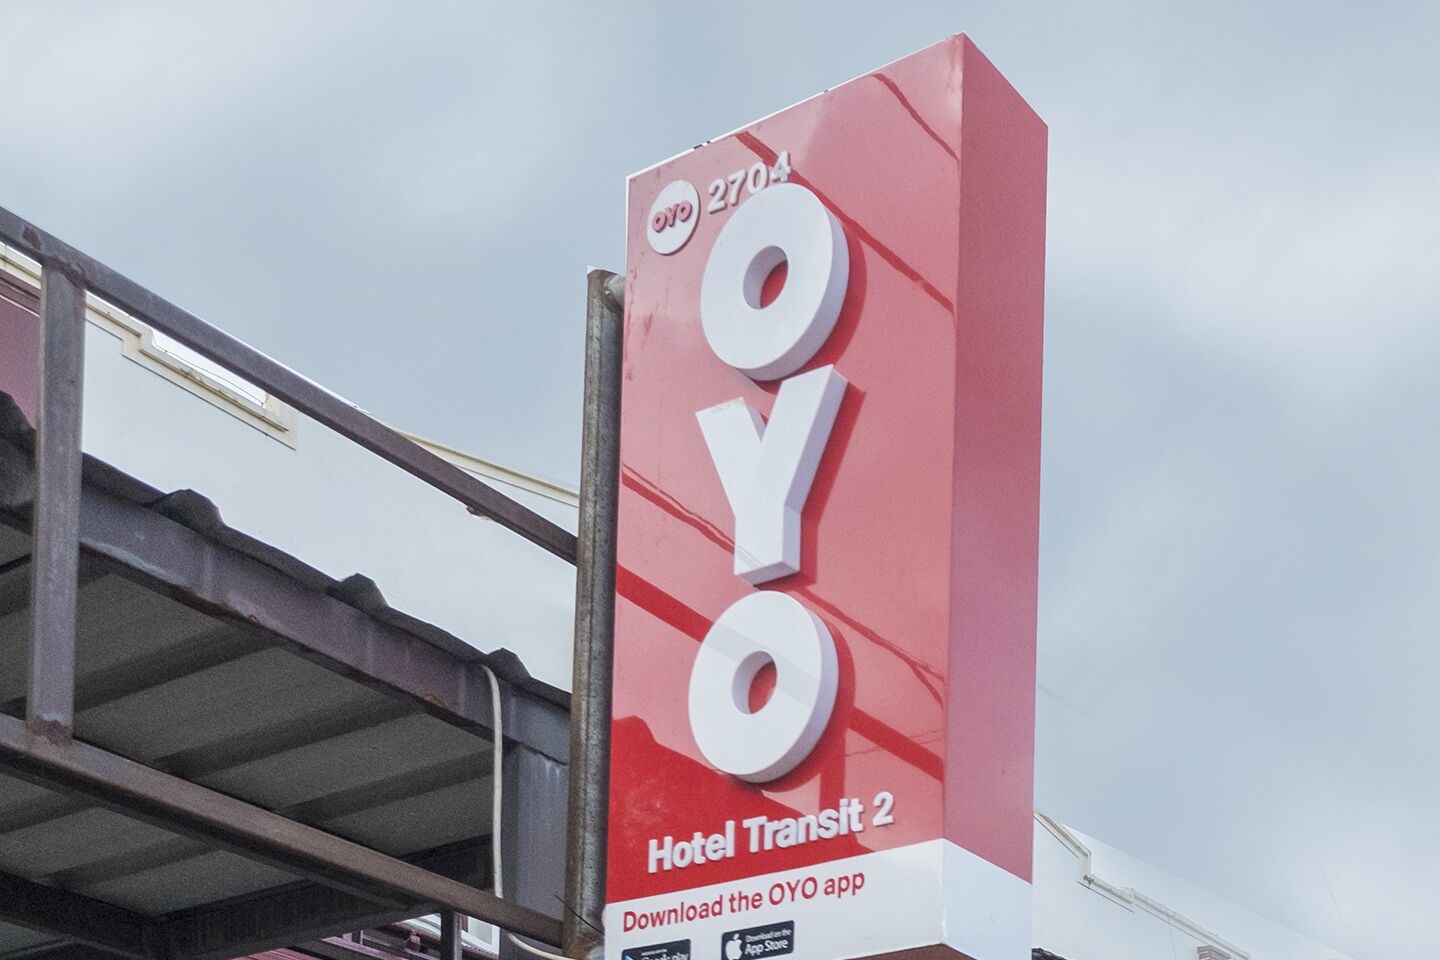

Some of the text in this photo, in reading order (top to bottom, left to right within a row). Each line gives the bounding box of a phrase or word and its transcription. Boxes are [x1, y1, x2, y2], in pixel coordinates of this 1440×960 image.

[651, 151, 792, 233] OYO 2704
[648, 791, 895, 873] Hotel Transit 2
[623, 871, 866, 933] Download the OYO app
[744, 939, 789, 956] App Store
[745, 931, 774, 943] Download
